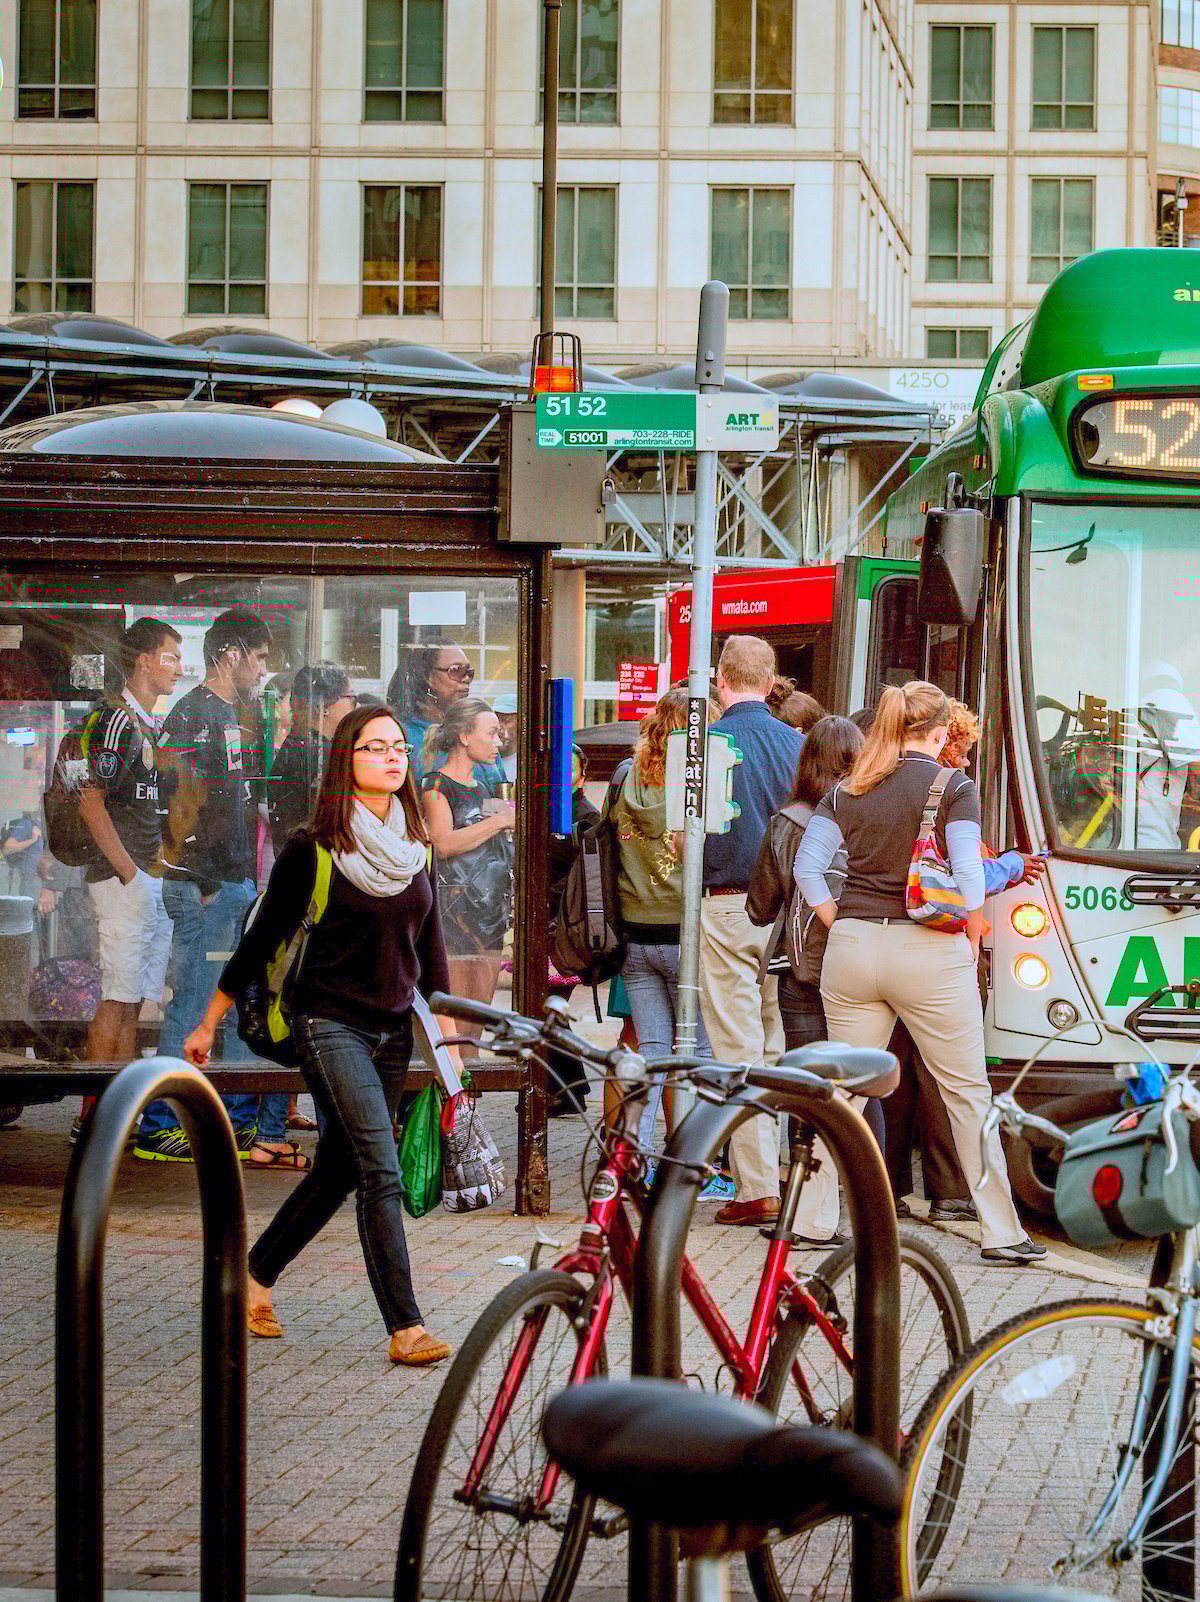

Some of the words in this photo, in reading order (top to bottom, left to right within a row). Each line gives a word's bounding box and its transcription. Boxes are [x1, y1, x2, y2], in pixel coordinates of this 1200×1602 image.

[896, 372, 949, 389] 4250
[546, 396, 570, 416] 51
[577, 396, 607, 416] 52
[951, 400, 973, 411] leas
[726, 413, 760, 426] ART
[569, 431, 605, 443] 51001
[632, 430, 692, 438] 703-228-RIDE
[614, 437, 692, 447] arlingtontransit.com
[721, 600, 768, 615] wmata.com
[1064, 885, 1136, 912] 5068
